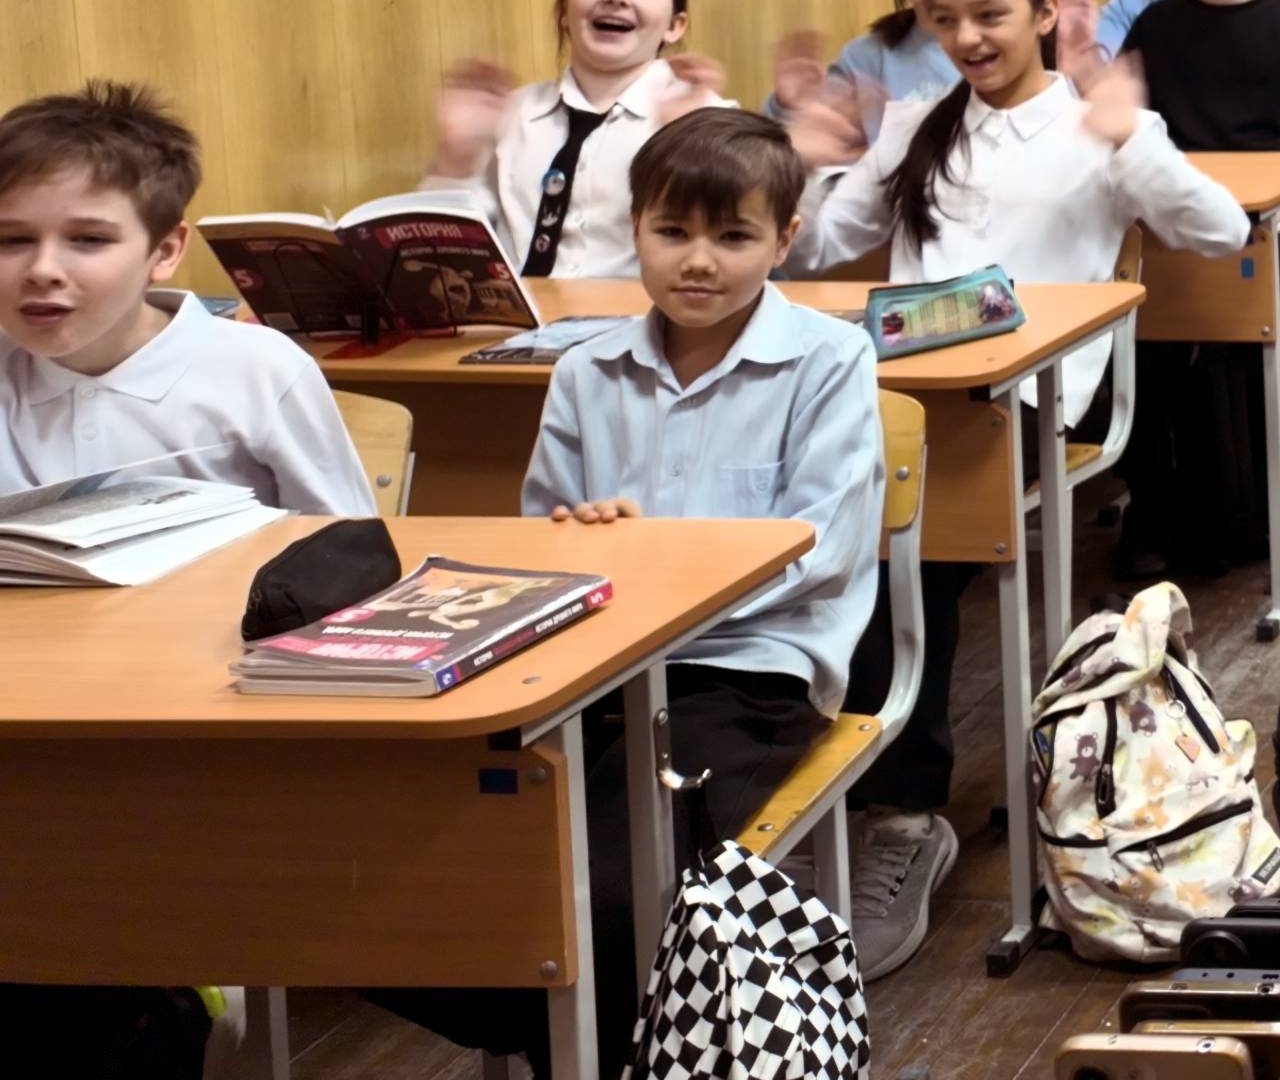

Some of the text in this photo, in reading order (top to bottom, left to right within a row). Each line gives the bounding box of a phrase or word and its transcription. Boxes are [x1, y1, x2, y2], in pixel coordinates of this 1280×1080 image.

[386, 222, 464, 240] ИСТОРИЯ
[233, 269, 254, 288] 5
[495, 262, 510, 279] 5
[307, 642, 430, 660] ИСТОРИЯ
